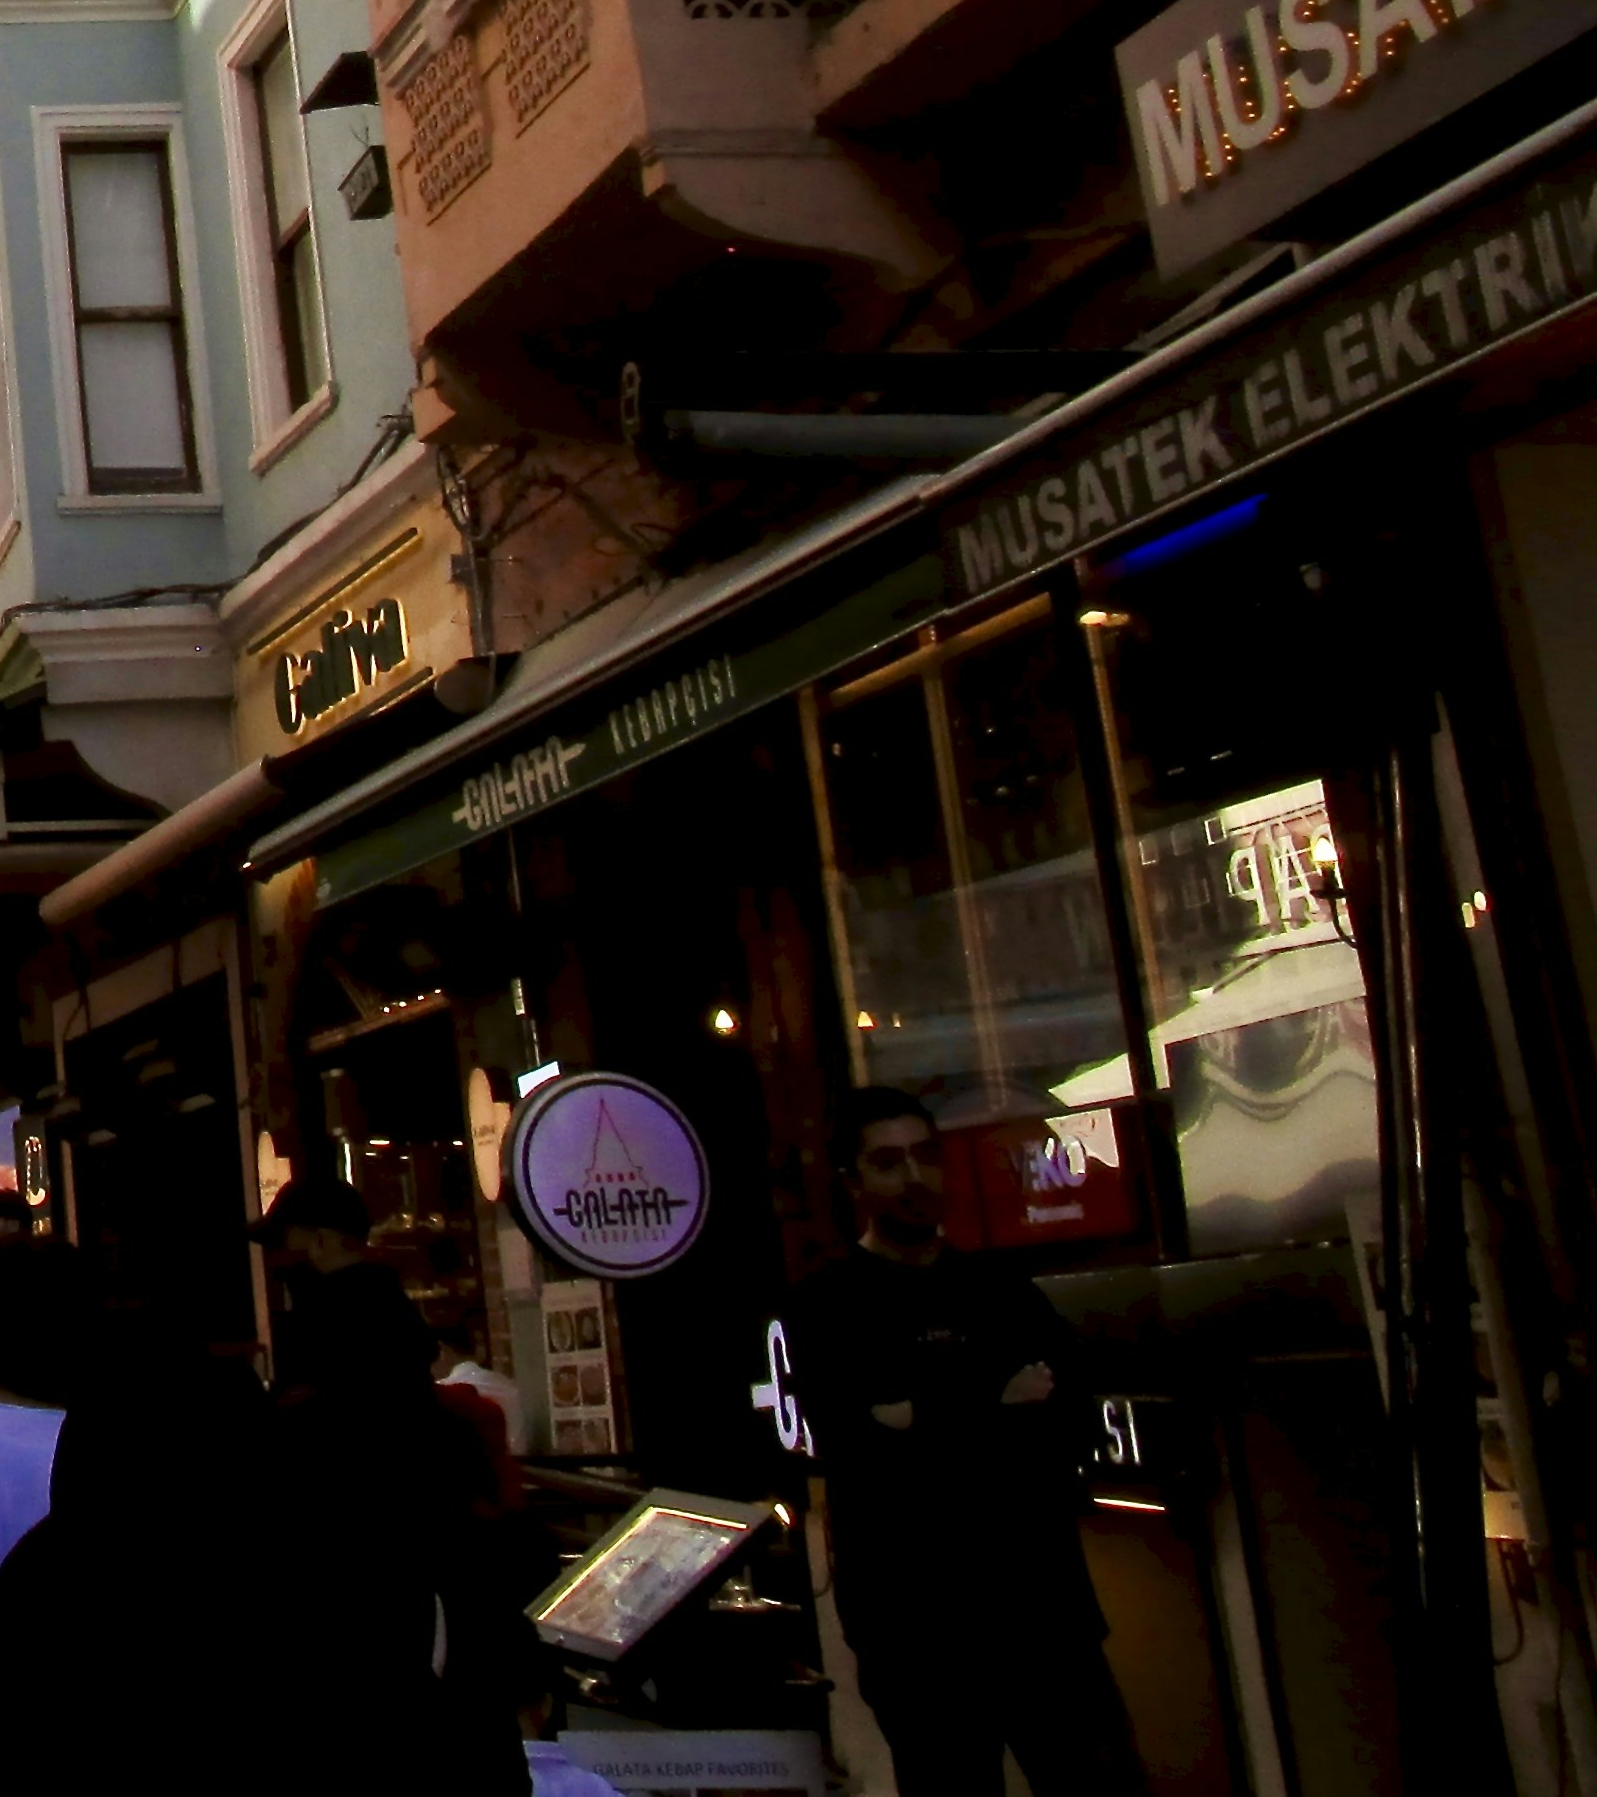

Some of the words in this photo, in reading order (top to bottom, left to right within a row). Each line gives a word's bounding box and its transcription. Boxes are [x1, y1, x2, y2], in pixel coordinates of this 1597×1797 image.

[958, 393, 1235, 594] MUSATEK
[453, 735, 585, 830] GALATA
[554, 1186, 689, 1230] GALATA
[594, 1761, 651, 1777] GALATA
[657, 1761, 704, 1777] KEBAP
[708, 1761, 790, 1778] FAVORITES
